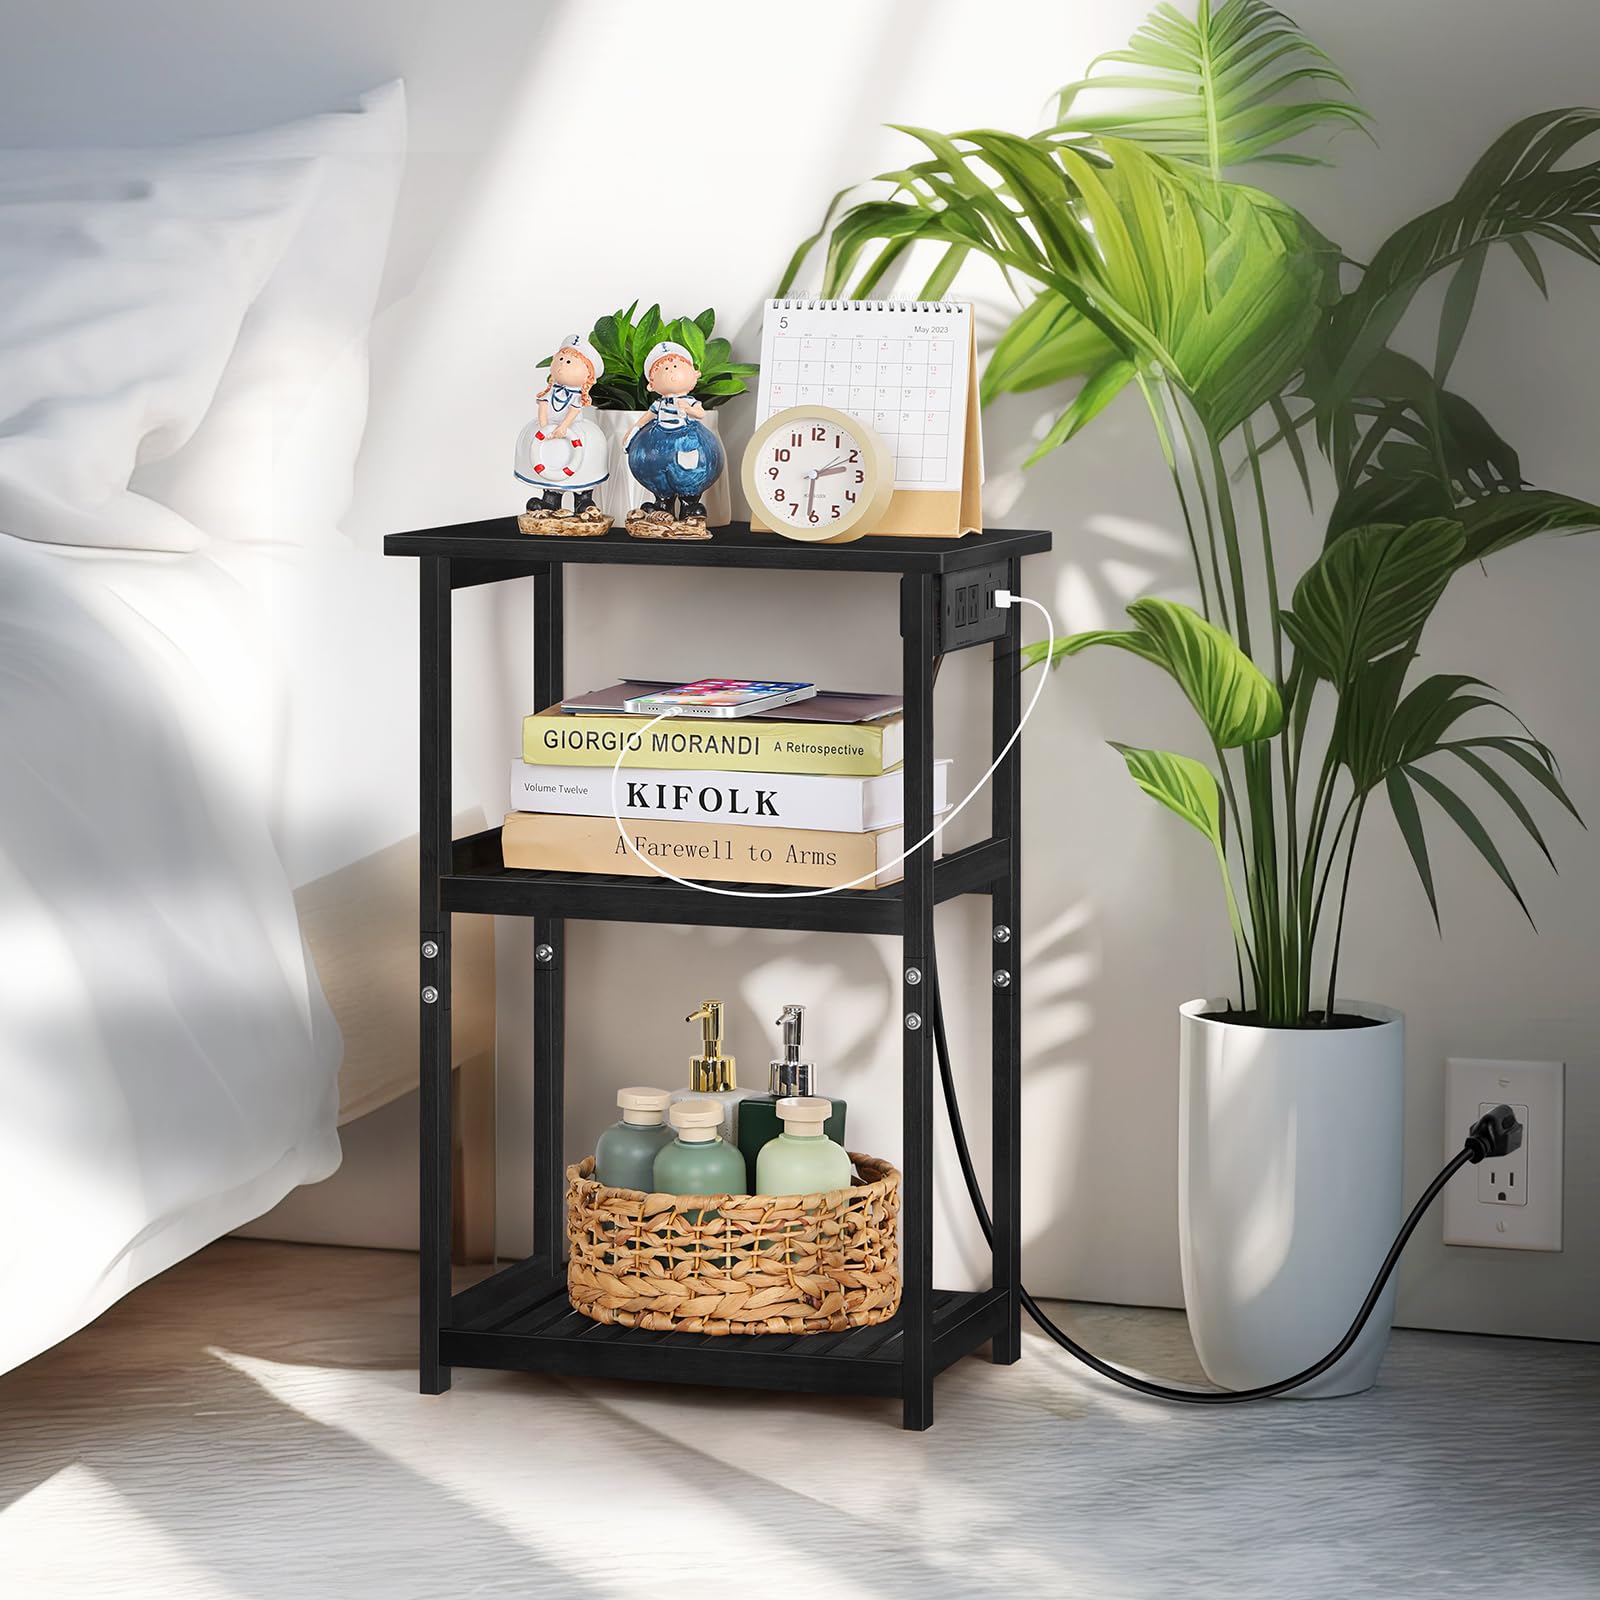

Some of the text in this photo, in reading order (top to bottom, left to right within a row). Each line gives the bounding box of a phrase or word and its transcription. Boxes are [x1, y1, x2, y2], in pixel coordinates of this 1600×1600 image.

[779, 316, 789, 329] 5
[914, 325, 949, 334] May 2023
[791, 434, 802, 447] 11
[812, 427, 826, 441] 12
[835, 435, 840, 448] 1
[774, 448, 790, 462] 10
[849, 449, 858, 463] 2
[768, 467, 779, 480] 9
[855, 470, 864, 483] 3
[774, 488, 785, 501] 8
[845, 490, 856, 503] 4
[789, 503, 799, 516] 7
[831, 505, 840, 518] 5
[808, 510, 819, 523] 6
[543, 728, 760, 756] GIORGIO MORANDI
[774, 740, 865, 758] A Retrospective
[524, 781, 589, 796] Volume Twelve
[625, 781, 781, 817] KIFOLK
[614, 834, 838, 867] A Farewell to Arms
